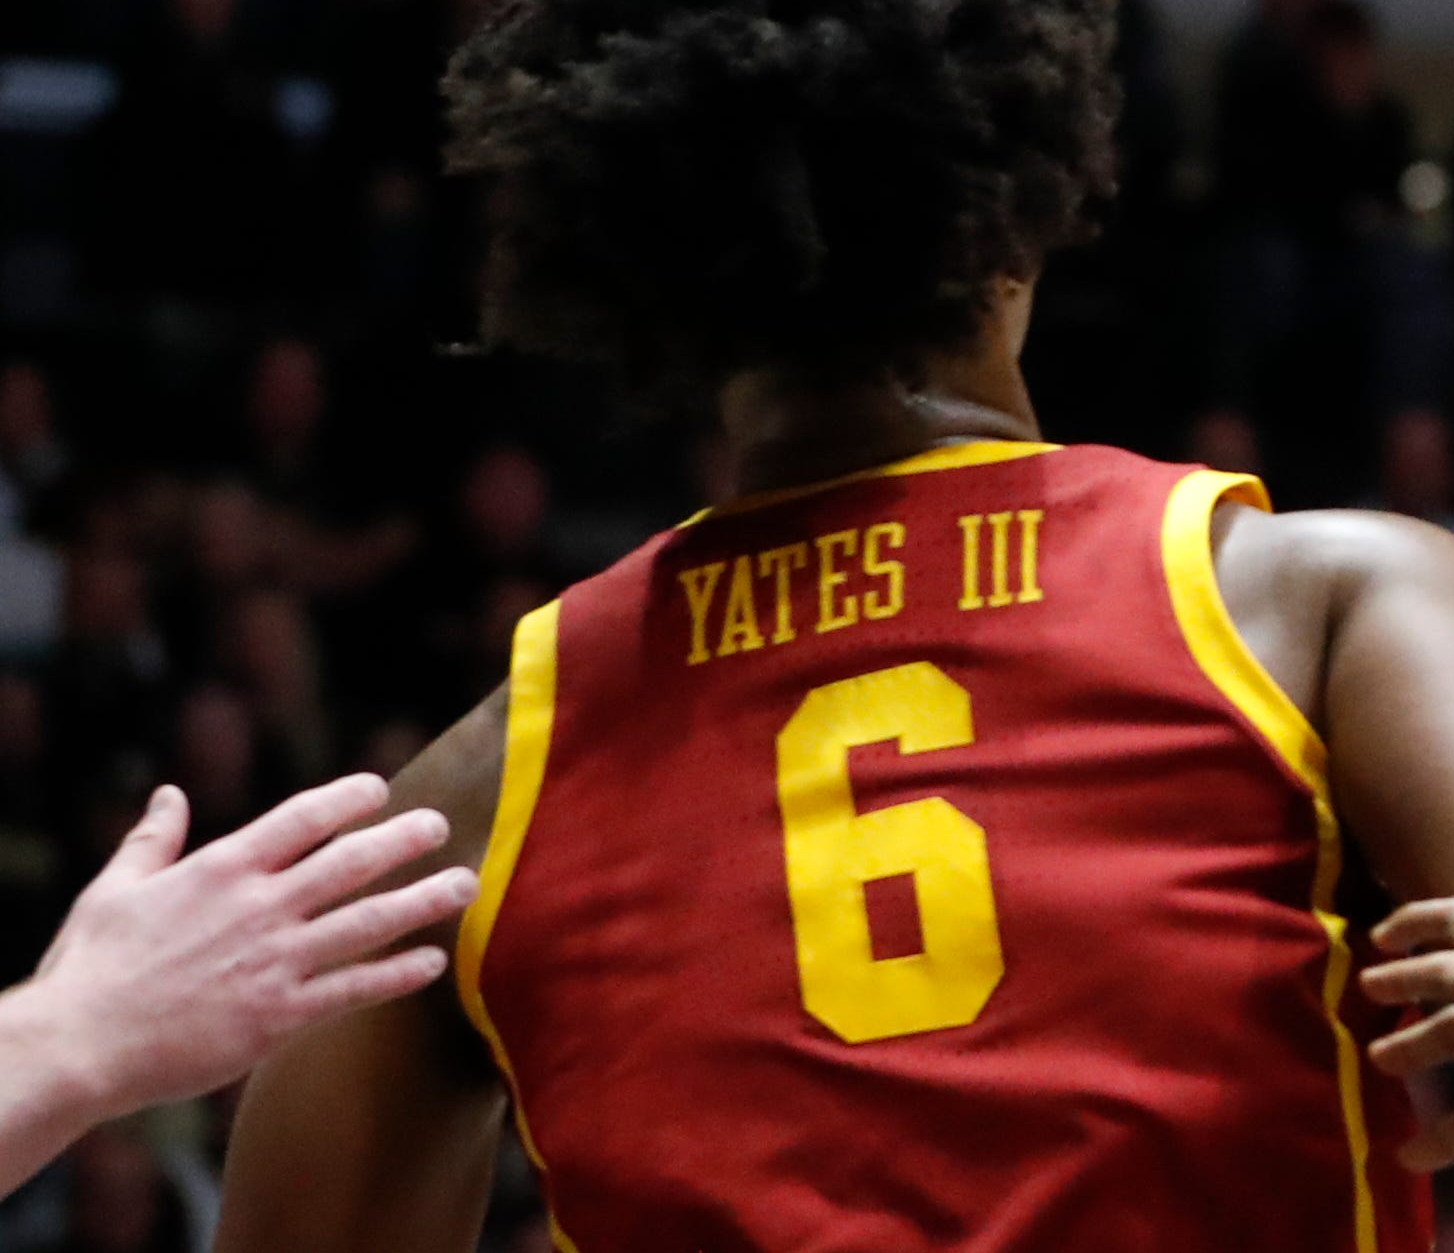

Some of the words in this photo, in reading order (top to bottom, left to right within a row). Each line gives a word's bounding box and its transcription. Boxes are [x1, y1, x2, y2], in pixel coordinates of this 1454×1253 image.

[679, 523, 905, 664] YATES
[959, 510, 1043, 610] III
[777, 661, 1004, 1043] 6
